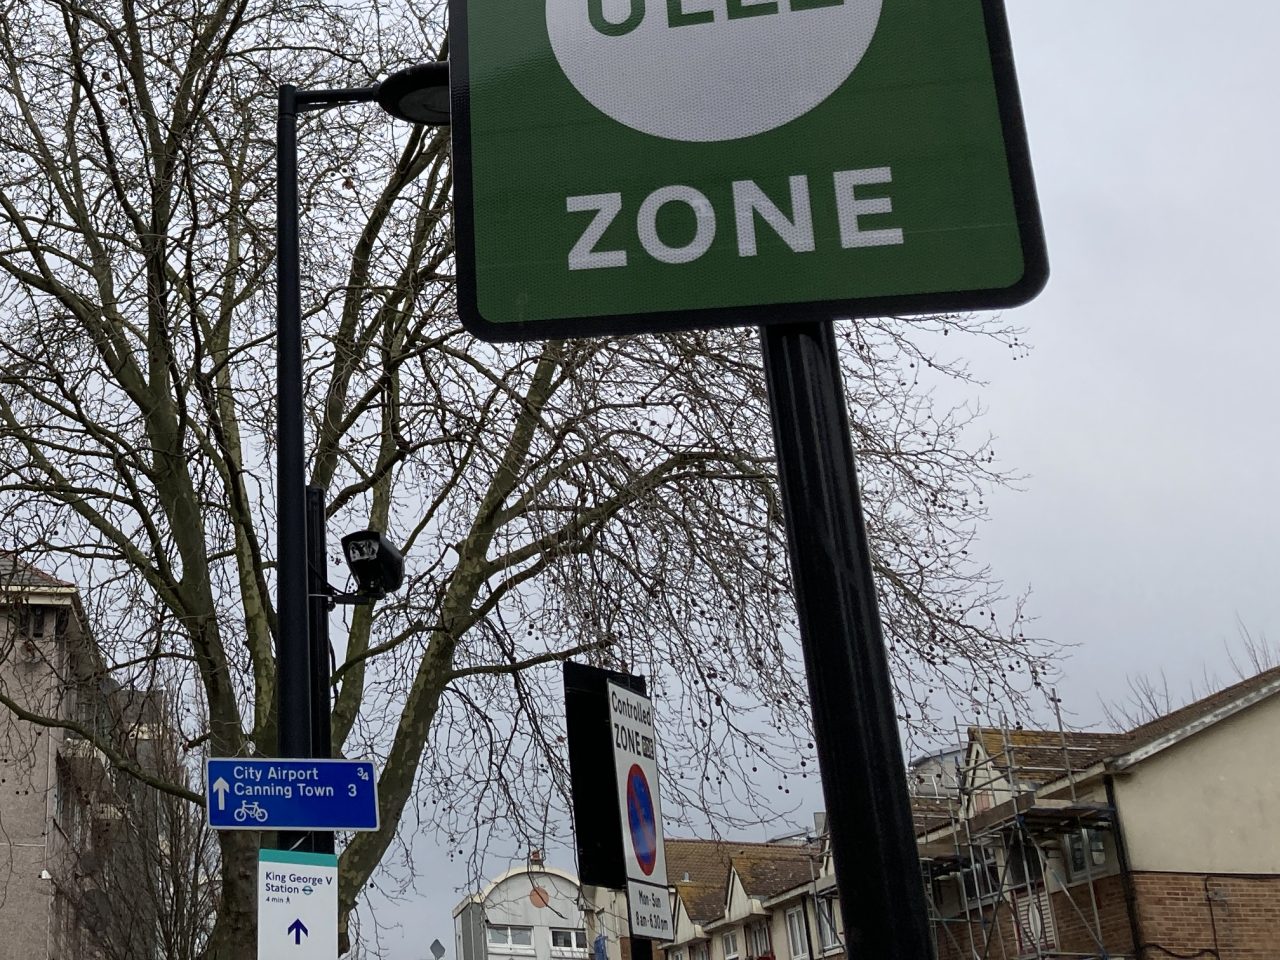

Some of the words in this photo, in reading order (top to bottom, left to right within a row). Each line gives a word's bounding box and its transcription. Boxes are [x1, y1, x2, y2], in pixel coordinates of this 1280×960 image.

[565, 166, 905, 271] ZONE
[611, 690, 652, 727] Controlled
[614, 722, 642, 757] ZONE
[233, 766, 262, 781] City
[268, 766, 319, 782] Airport
[234, 782, 293, 799] Canning
[297, 783, 334, 797] Town
[347, 783, 358, 797] 3
[265, 871, 286, 884] King
[289, 873, 323, 887] George
[325, 876, 333, 886] V
[265, 882, 300, 894] Station
